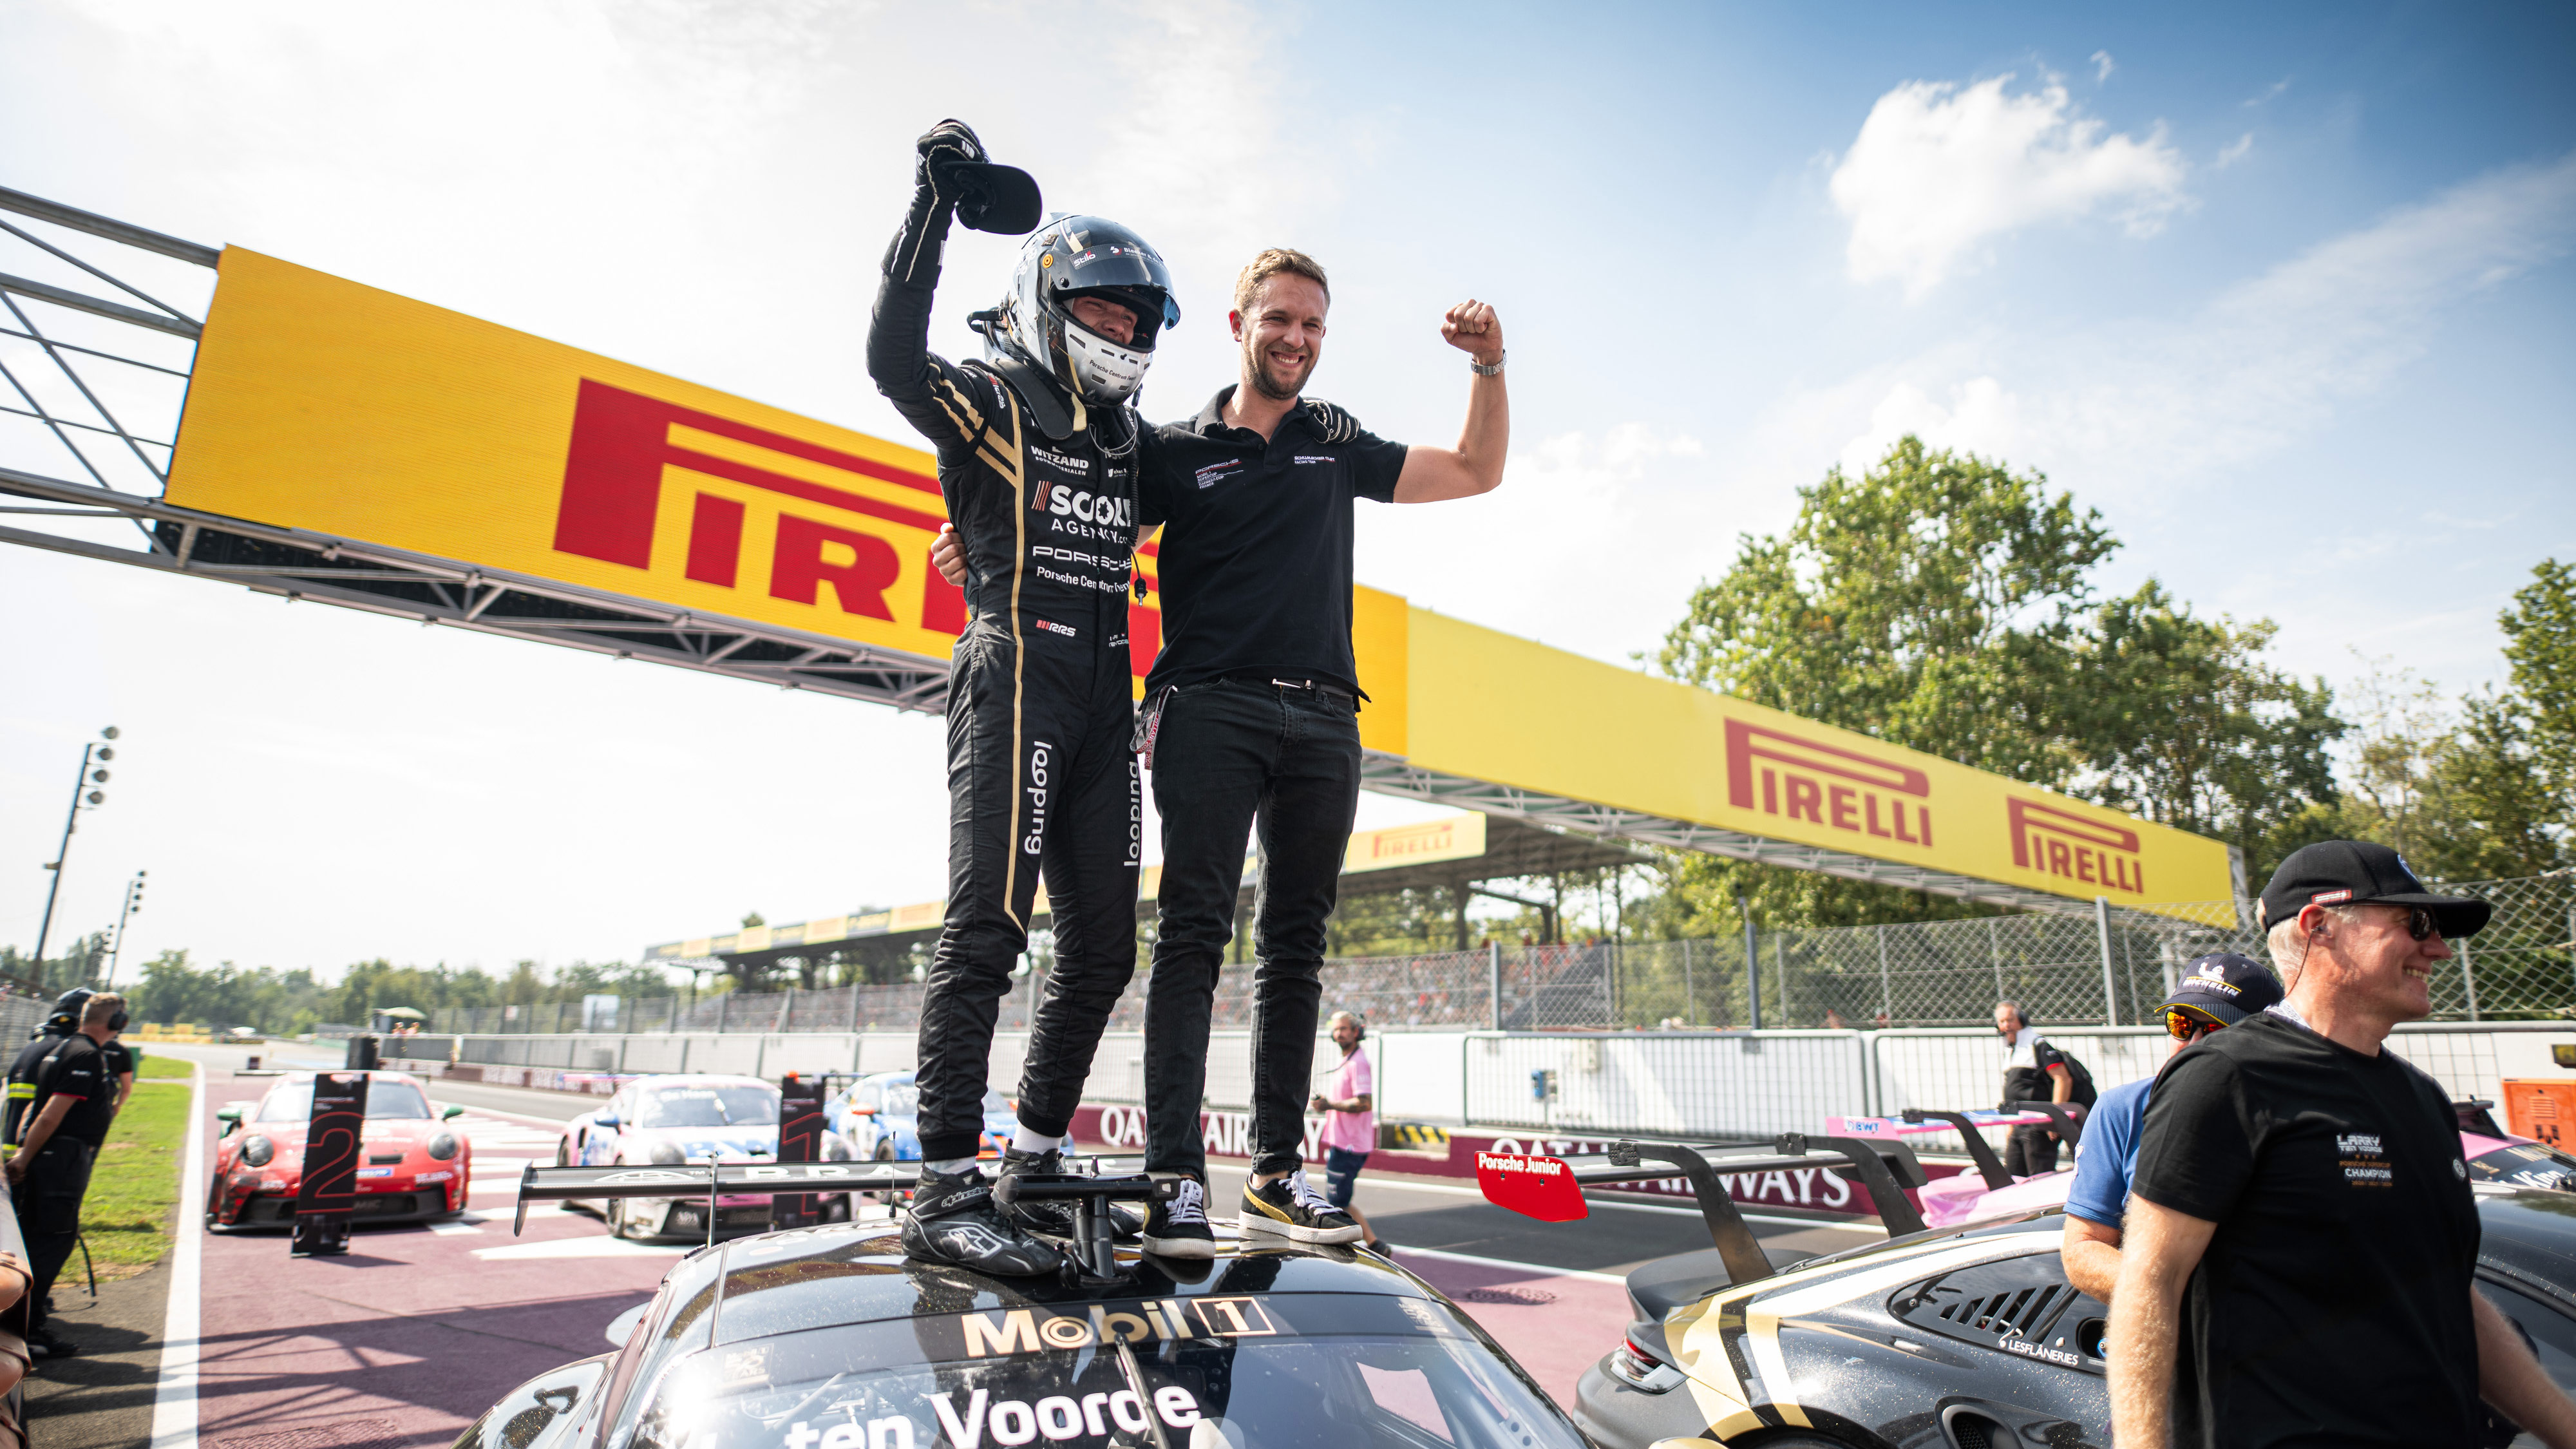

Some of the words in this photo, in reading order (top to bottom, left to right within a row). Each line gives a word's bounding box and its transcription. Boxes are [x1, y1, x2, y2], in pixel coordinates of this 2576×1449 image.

[1074, 251, 1096, 267] stilo
[1089, 359, 1108, 374] Porsche
[1109, 370, 1127, 381] Centrum
[1030, 445, 1089, 469] WITZAND
[1195, 459, 1239, 474] PORSCHE
[1032, 545, 1132, 571] PORSCHE
[1036, 566, 1079, 585] Porsche
[1048, 622, 1077, 638] RRS
[1724, 716, 1933, 848] PIRELLI
[1024, 740, 1052, 855] looping
[1124, 761, 1142, 866] looping
[1373, 823, 1453, 858] PIRELLI
[2007, 795, 2144, 895] PIRELLI
[2182, 978, 2240, 998] MICHELIN
[2336, 1134, 2380, 1146] LARRY
[296, 1110, 365, 1214] 2
[782, 1112, 824, 1215] 1
[1478, 1153, 1524, 1173] Porsche
[1525, 1156, 1562, 1176] Junior
[2344, 1168, 2392, 1179] CHAMPION
[961, 1300, 1193, 1358] Mobil
[2008, 1338, 2079, 1366] LESFLÂNERIES
[783, 1414, 916, 1449] ten
[929, 1385, 1202, 1449] Voorde
